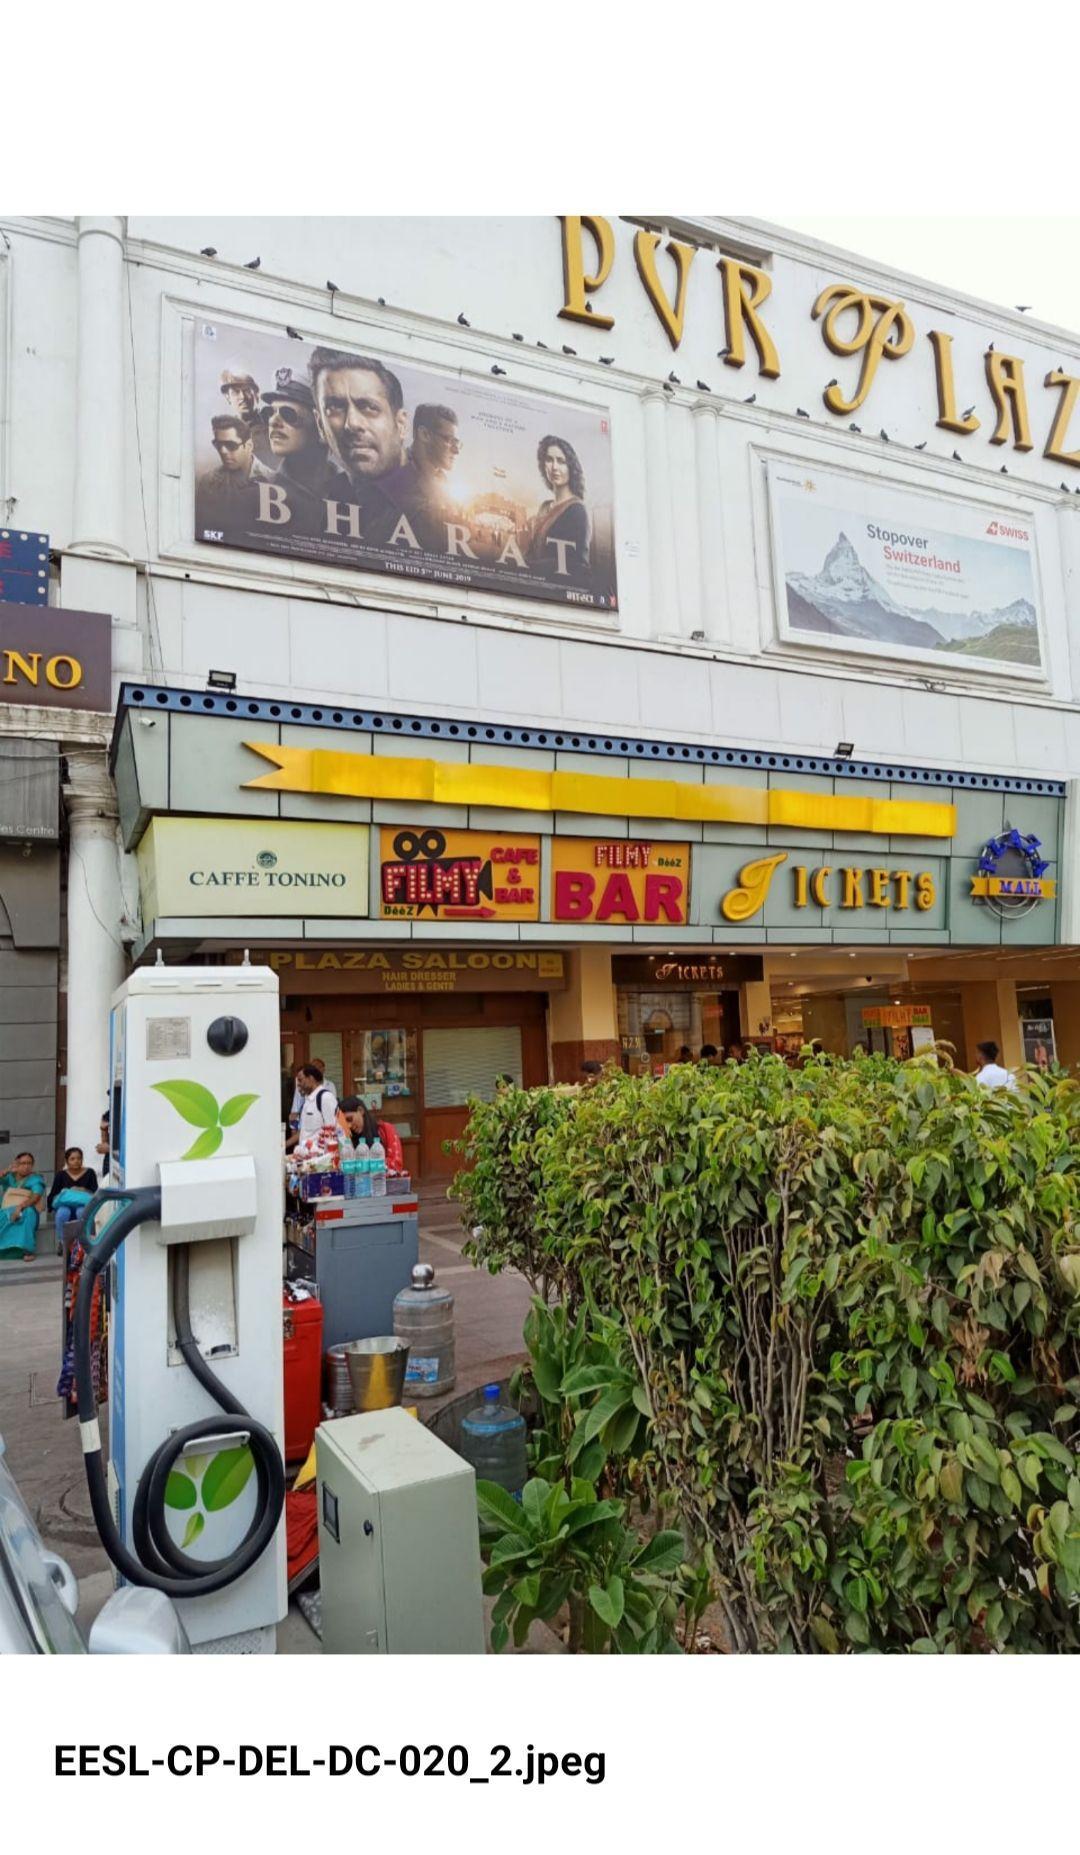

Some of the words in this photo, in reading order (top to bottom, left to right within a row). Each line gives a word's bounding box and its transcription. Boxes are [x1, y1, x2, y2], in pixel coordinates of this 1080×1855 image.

[557, 216, 781, 379] PVR
[203, 530, 224, 540] SKF
[256, 481, 577, 576] BHARAT
[867, 524, 929, 550] Stopover
[999, 524, 1030, 541] SWISS
[883, 546, 961, 574] Switzerland
[434, 570, 453, 580] JUNE
[455, 574, 471, 582] 2019
[490, 847, 538, 865] CAFE
[594, 845, 651, 869] FILMY
[264, 872, 347, 888] TONINO
[382, 860, 482, 904] FILMY
[506, 868, 522, 885] &
[495, 887, 535, 905] BAR
[555, 870, 684, 922] BAR
[720, 852, 937, 923] TICKETS
[999, 880, 1042, 896] MALL
[269, 952, 392, 970] PLAZA
[402, 952, 539, 970] SALOON
[382, 971, 408, 981] HAIR
[410, 971, 456, 981] DRESSER
[655, 963, 724, 980] TICKETS
[385, 982, 416, 991] LADIES
